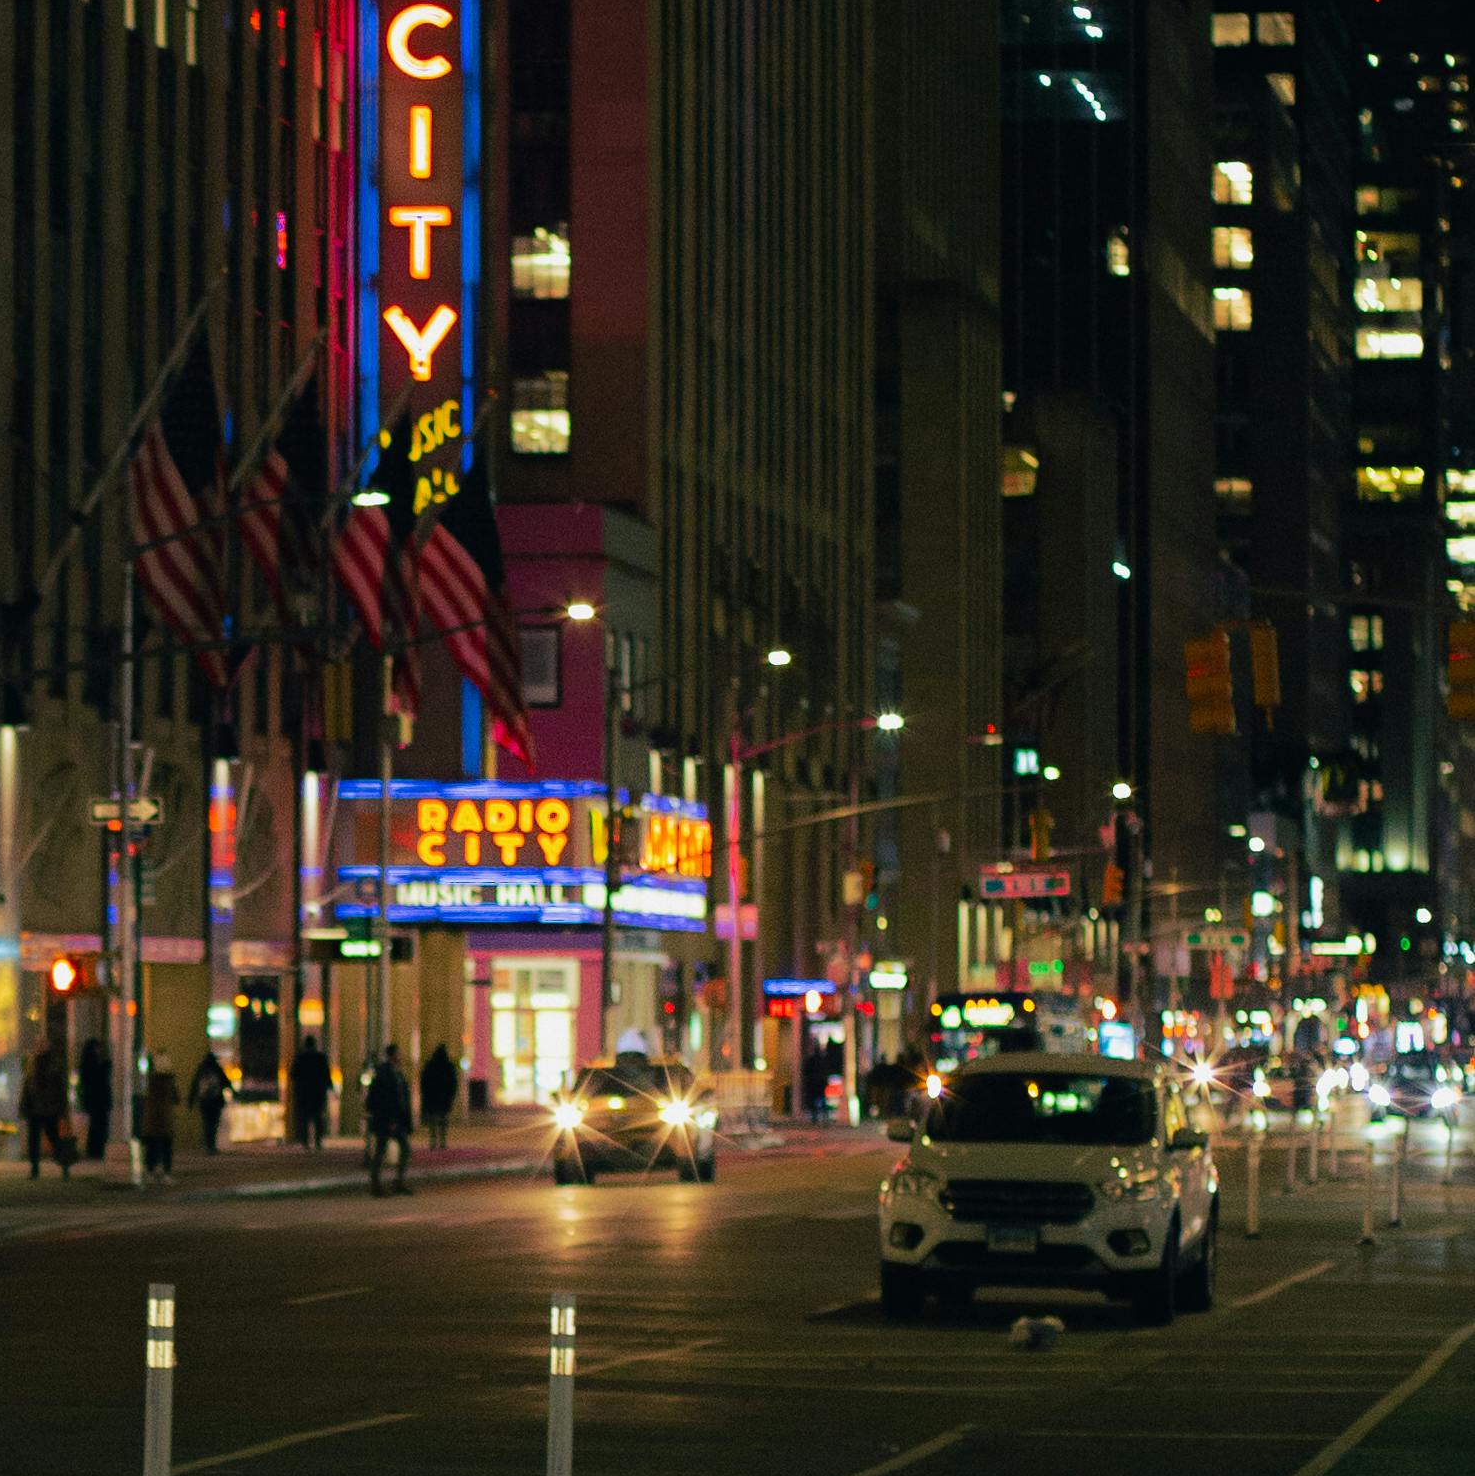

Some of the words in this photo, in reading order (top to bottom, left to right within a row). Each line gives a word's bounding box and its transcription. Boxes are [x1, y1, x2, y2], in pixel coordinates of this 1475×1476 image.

[382, 0, 458, 381] CITY
[379, 398, 461, 462] SIC
[416, 797, 571, 834] RADIO
[416, 833, 568, 867] CITY
[395, 881, 483, 908] MUSIC
[494, 882, 567, 908] HALL
